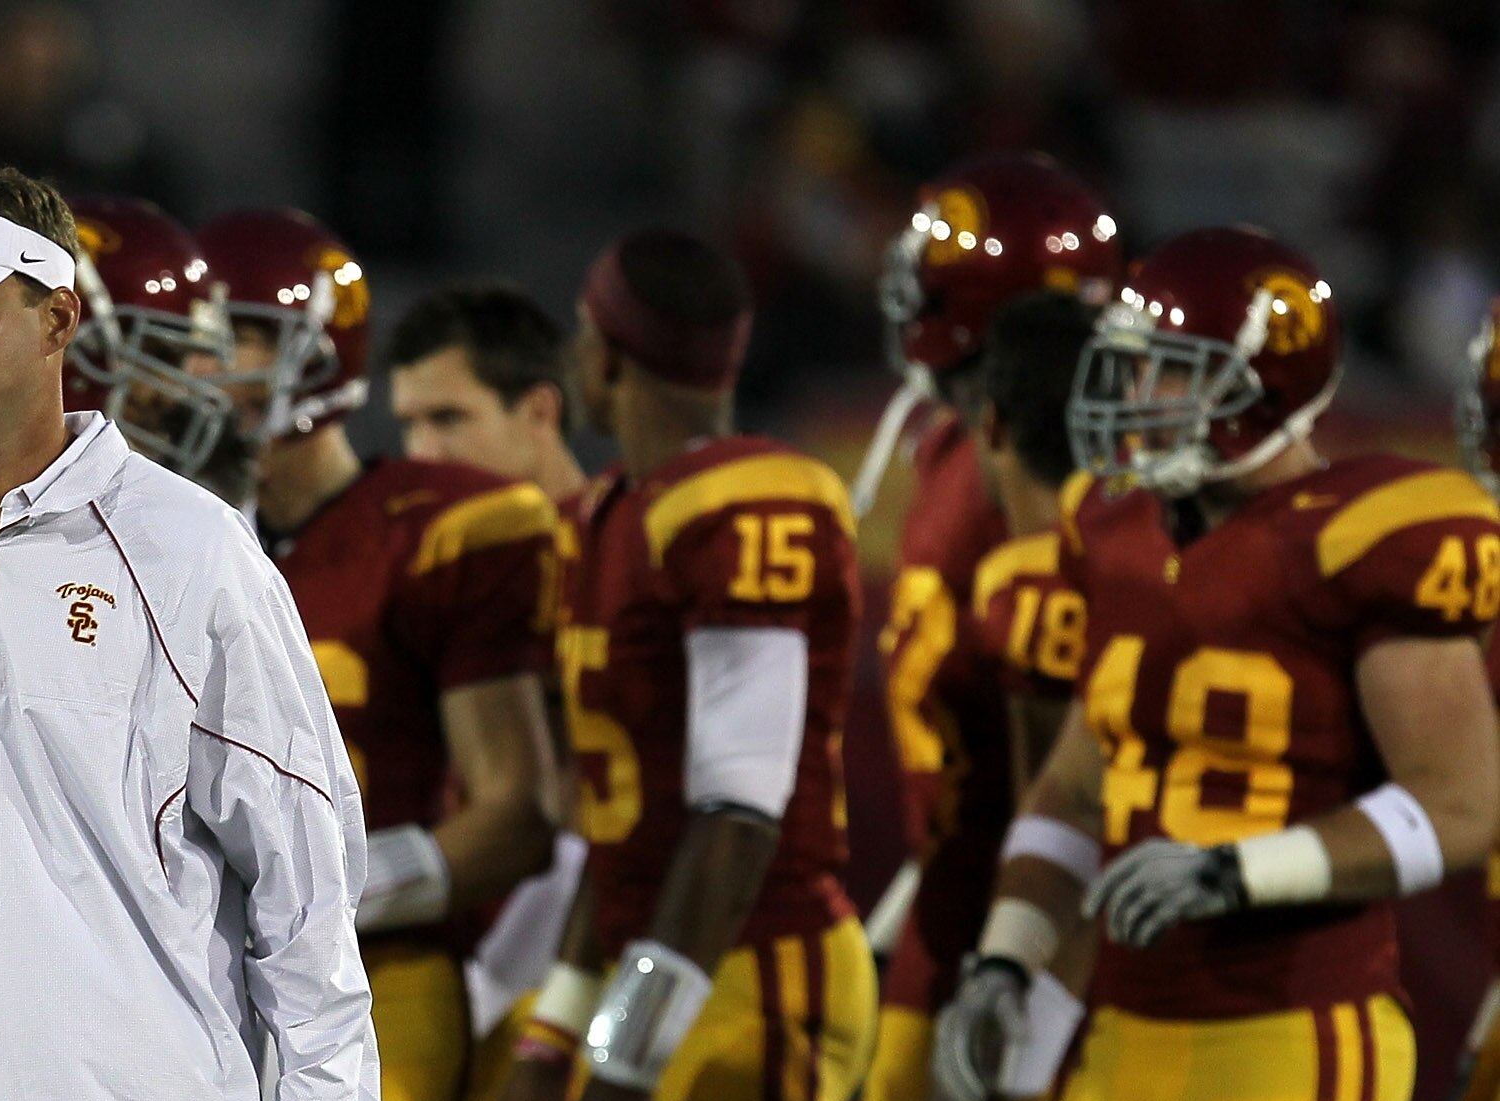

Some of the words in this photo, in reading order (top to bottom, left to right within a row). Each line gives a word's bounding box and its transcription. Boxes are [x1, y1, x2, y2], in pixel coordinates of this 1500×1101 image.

[55, 582, 116, 605] Trojans
[726, 513, 816, 603] 15
[67, 601, 98, 644] SC
[1007, 587, 1088, 681] 18
[1085, 634, 1295, 849] 48
